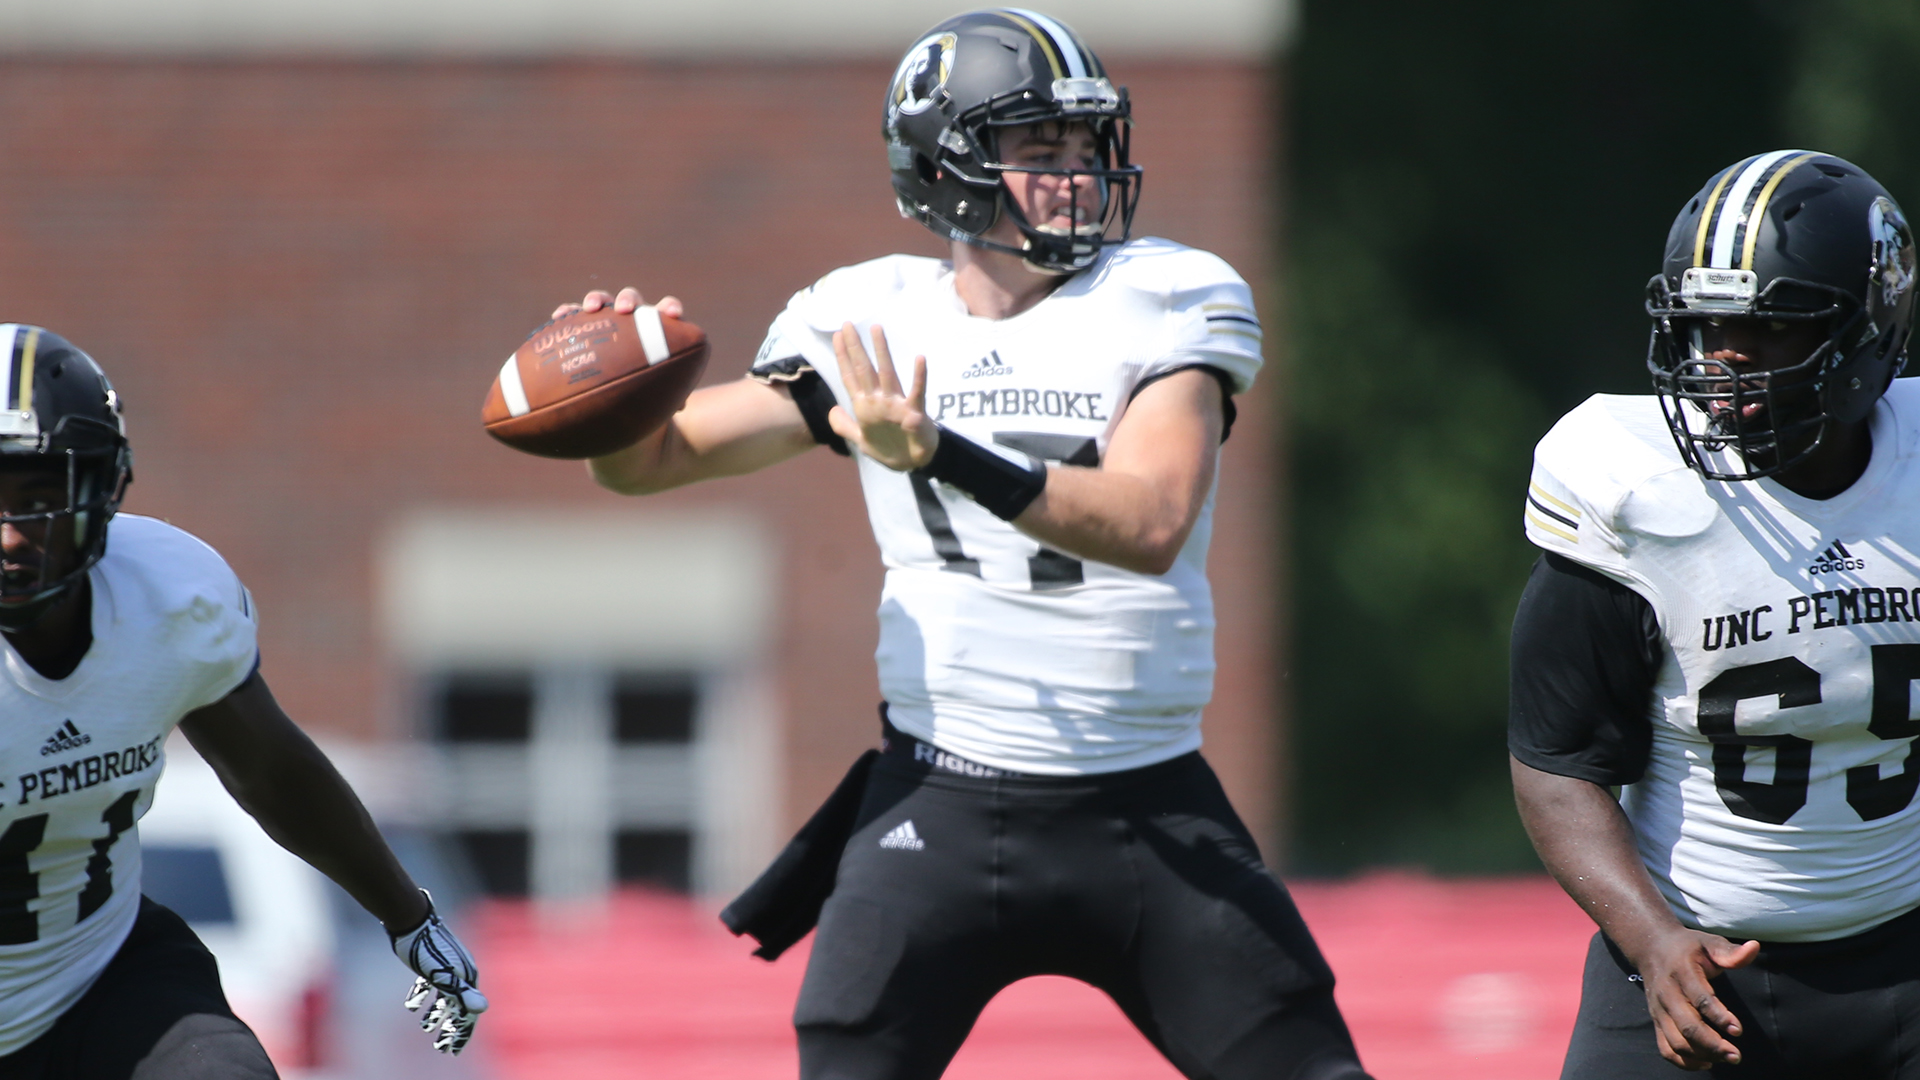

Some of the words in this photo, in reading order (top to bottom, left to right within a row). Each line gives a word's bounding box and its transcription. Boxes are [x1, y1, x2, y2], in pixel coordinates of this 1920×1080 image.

[534, 318, 612, 353] Wilson
[561, 350, 598, 374] NCAA
[961, 364, 1014, 380] adidas
[935, 388, 1108, 422] PEMBROKE
[1808, 556, 1866, 576] adidas
[1702, 604, 1773, 652] UNC
[40, 732, 92, 757] adidas
[1697, 643, 1920, 826] 65
[18, 733, 162, 806] PEMBROKE
[879, 836, 925, 851] adidas
